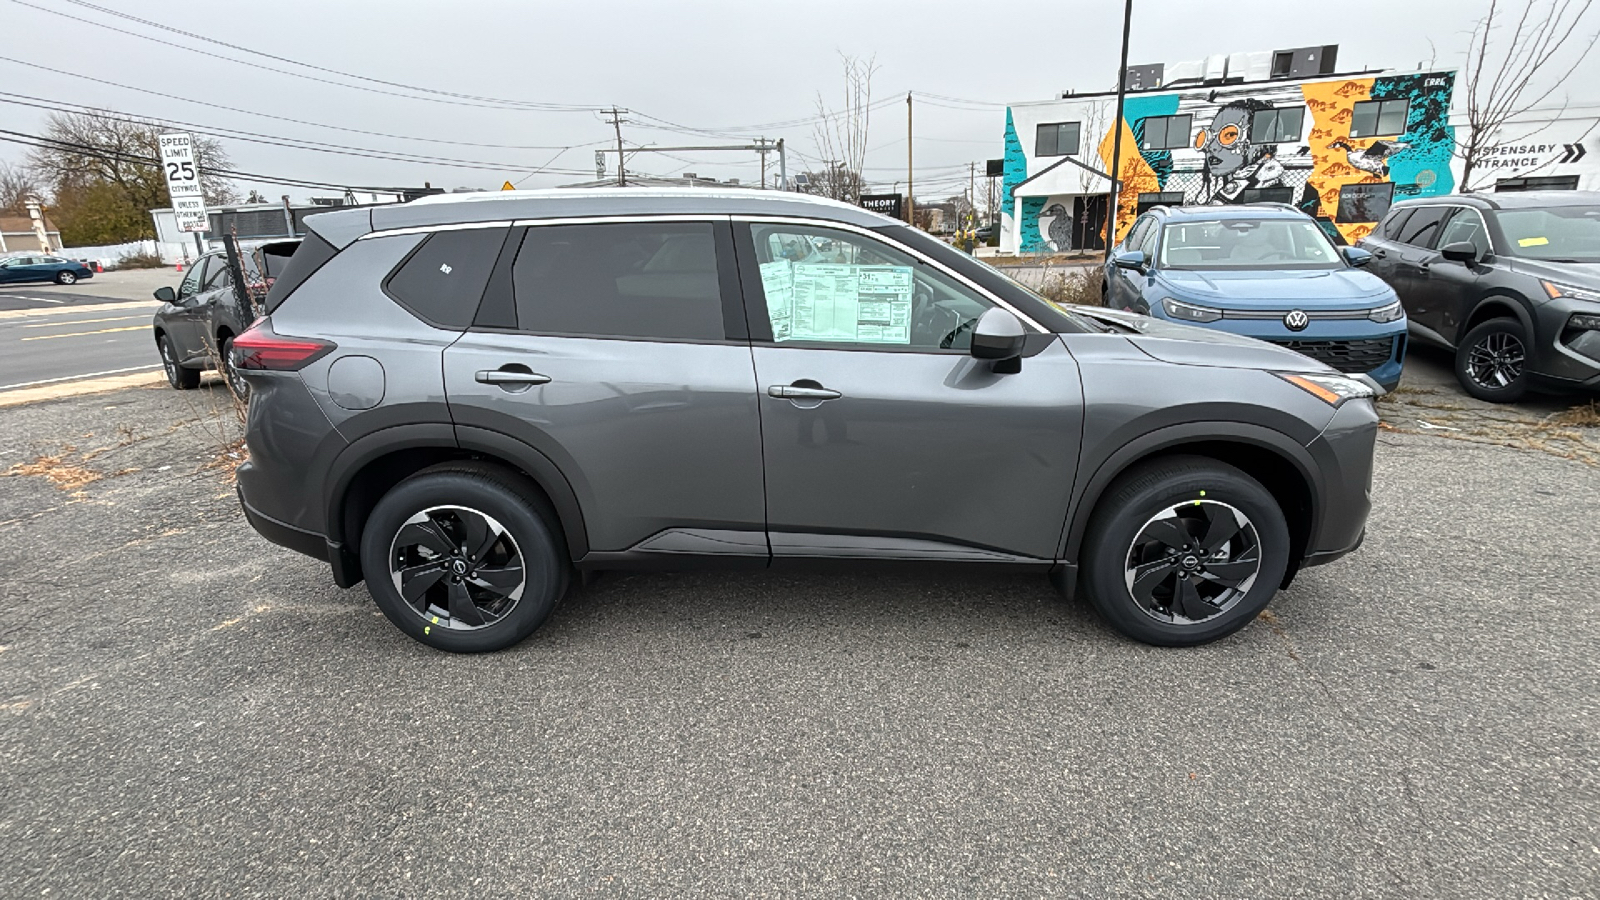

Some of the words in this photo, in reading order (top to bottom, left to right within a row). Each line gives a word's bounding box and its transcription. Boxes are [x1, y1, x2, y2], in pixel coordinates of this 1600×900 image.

[161, 138, 189, 147] SPEED
[165, 149, 188, 157] LIMIT
[1471, 157, 1539, 169] NTRANCE
[167, 162, 194, 180] 25
[1286, 310, 1308, 327] VW
